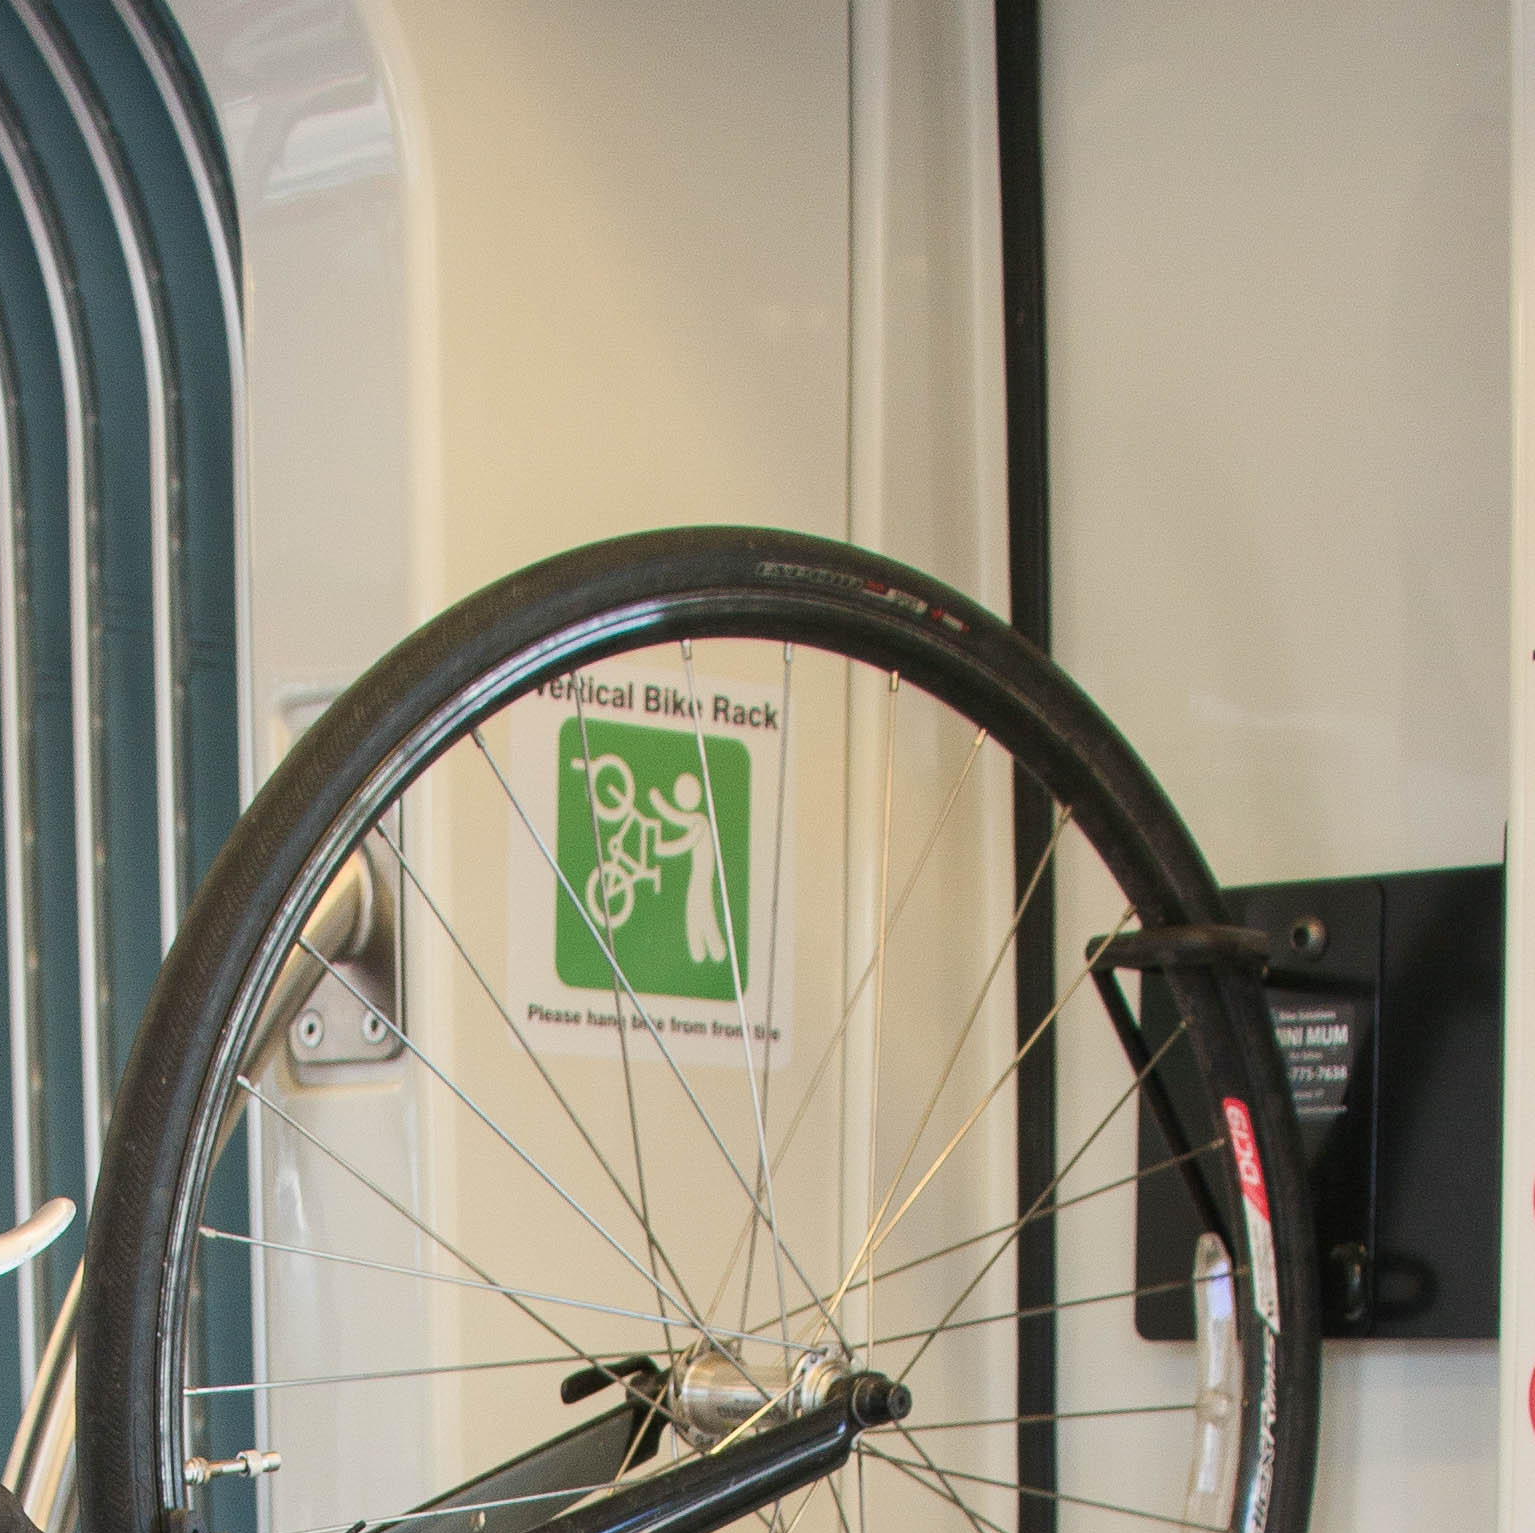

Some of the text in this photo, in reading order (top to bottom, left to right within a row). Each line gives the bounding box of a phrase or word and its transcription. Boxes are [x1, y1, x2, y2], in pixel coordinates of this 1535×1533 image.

[644, 684, 702, 720] Bike
[714, 693, 778, 729] Rack
[527, 1002, 581, 1024] Please
[712, 1019, 750, 1038] fron
